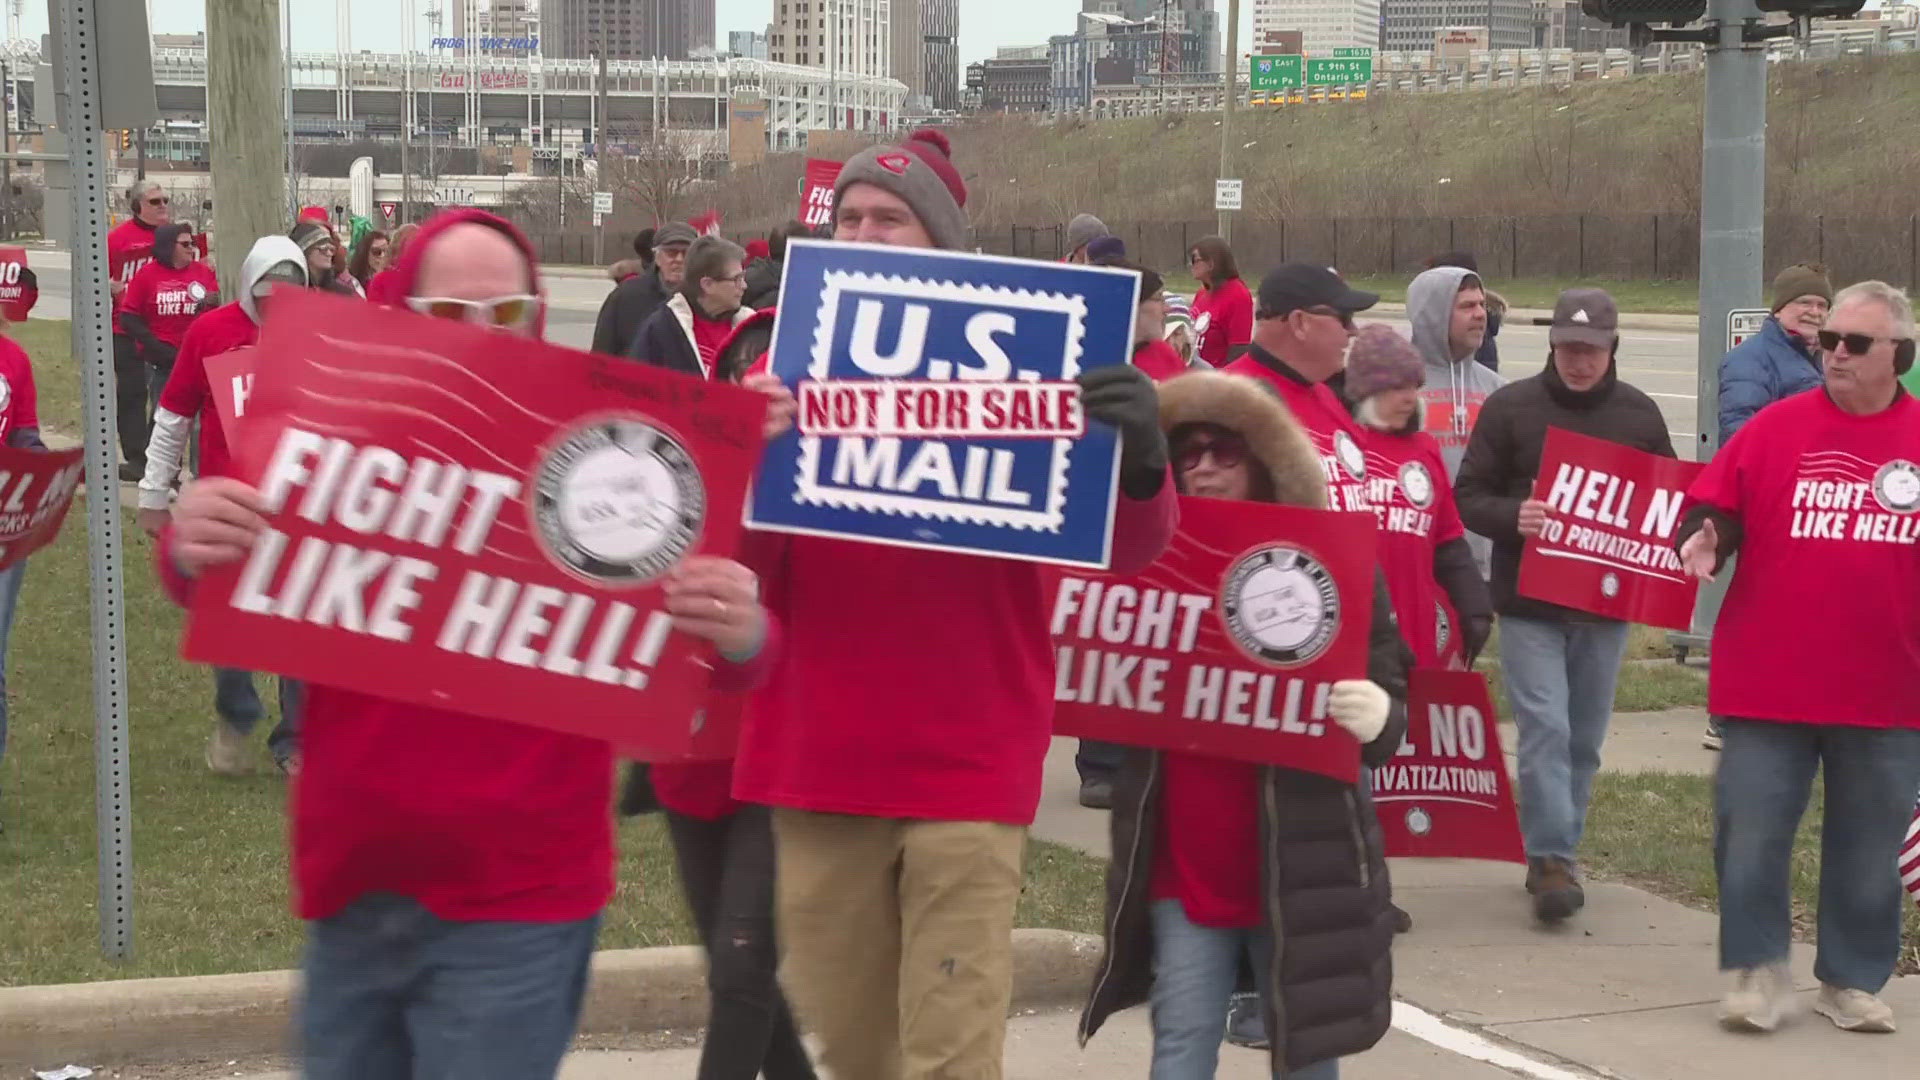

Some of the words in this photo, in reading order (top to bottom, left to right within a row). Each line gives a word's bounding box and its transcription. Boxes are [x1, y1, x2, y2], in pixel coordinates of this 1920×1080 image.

[507, 37, 539, 49] FIELD
[1258, 77, 1277, 85] Erie
[1282, 77, 1293, 85] Pa
[1259, 62, 1271, 73] 90
[1314, 73, 1349, 81] Ontario
[1353, 73, 1365, 81] St
[1329, 62, 1345, 71] 9th
[1349, 62, 1361, 71] St
[157, 303, 182, 316] LIKE
[848, 299, 1041, 383] U.S.
[804, 388, 885, 431] NOT
[893, 388, 975, 432] FOR
[981, 388, 1080, 433] SALE
[832, 436, 1031, 507] MAIL
[259, 427, 522, 557] FIGHT
[1547, 462, 1636, 530] HELL
[1640, 487, 1685, 539] N
[1791, 480, 1870, 511] FIGHT
[1540, 517, 1564, 543] TO
[1790, 510, 1850, 540] LIKE
[230, 528, 440, 643] LIKE
[436, 570, 675, 690] HELL!
[1050, 576, 1214, 654] FIGHT
[1054, 645, 1172, 715] LIKE
[1182, 664, 1334, 738] HELL!
[1428, 702, 1487, 762] NO
[1370, 763, 1499, 797] IVATIZATION!
